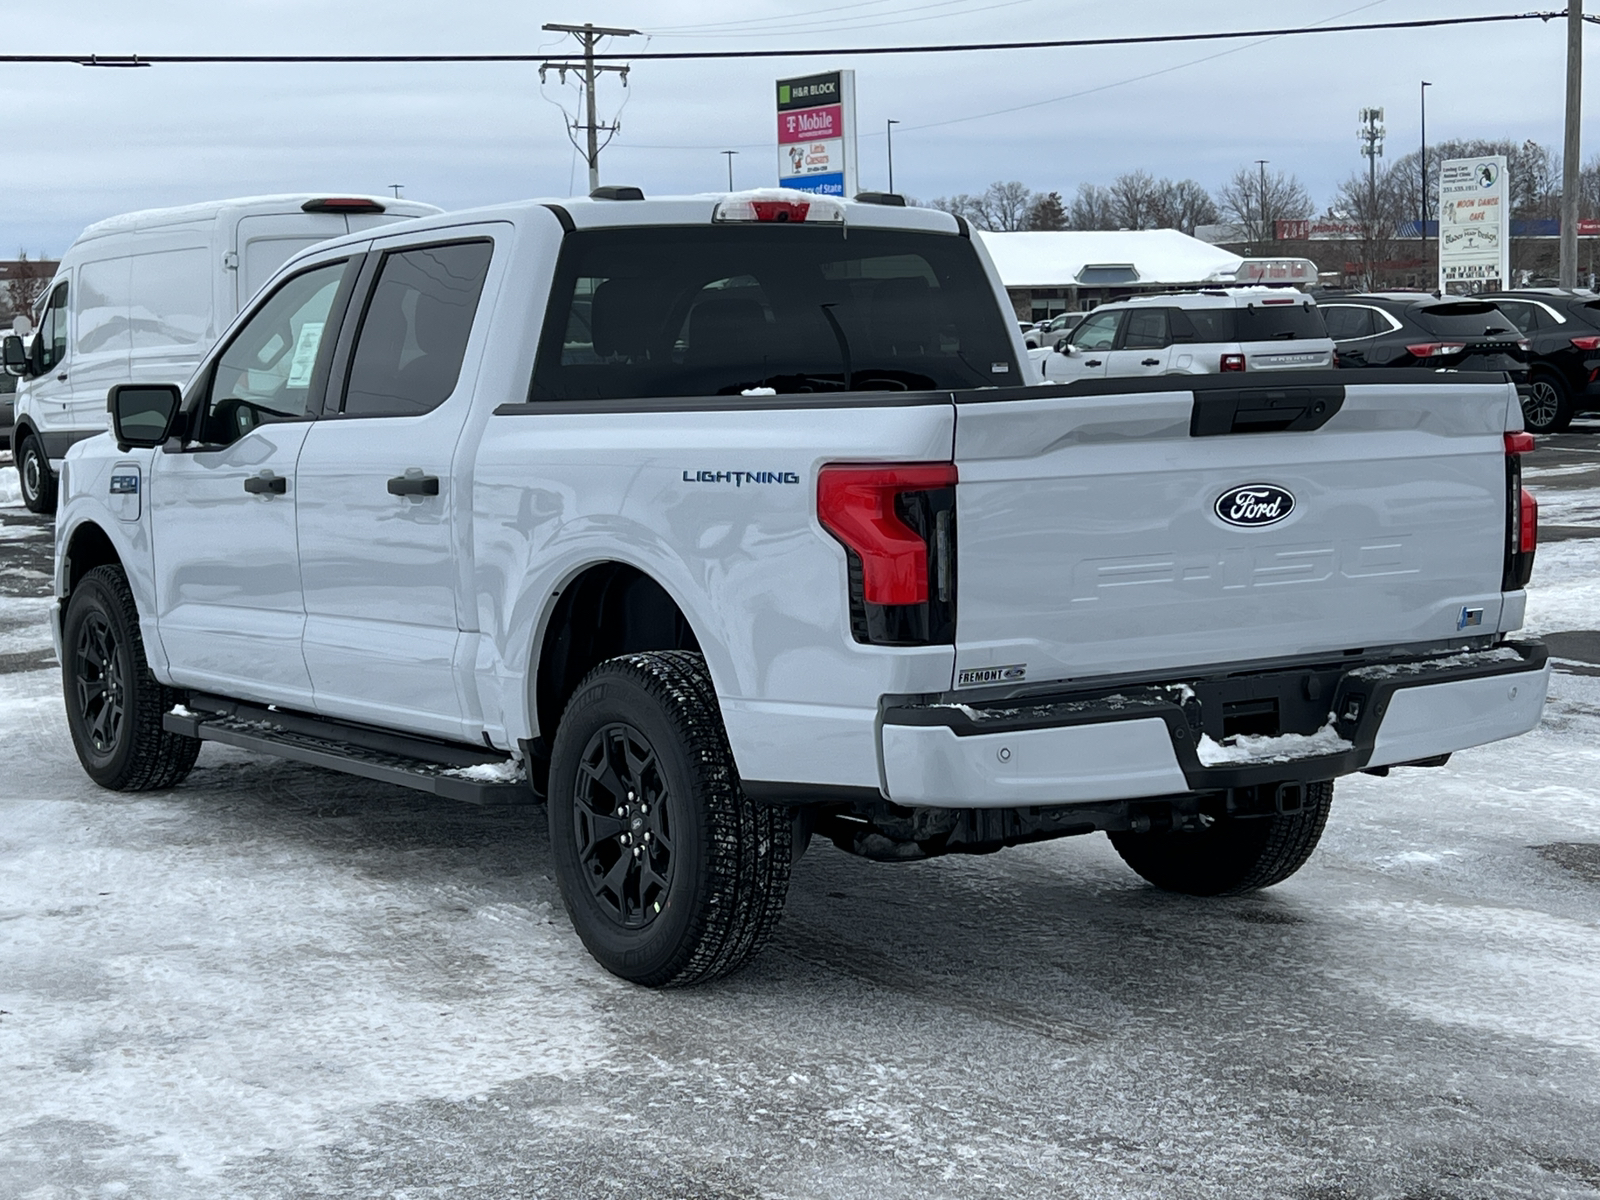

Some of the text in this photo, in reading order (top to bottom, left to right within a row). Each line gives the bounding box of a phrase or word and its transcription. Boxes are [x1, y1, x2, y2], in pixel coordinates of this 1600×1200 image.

[793, 82, 835, 98] H&R BLOCK
[798, 111, 833, 132] Mobile
[823, 183, 842, 194] State
[1456, 196, 1499, 208] MOON DANCE
[682, 470, 800, 487] LIGHTNING
[1230, 490, 1282, 519] Ford
[958, 669, 1003, 684] FREMONT
